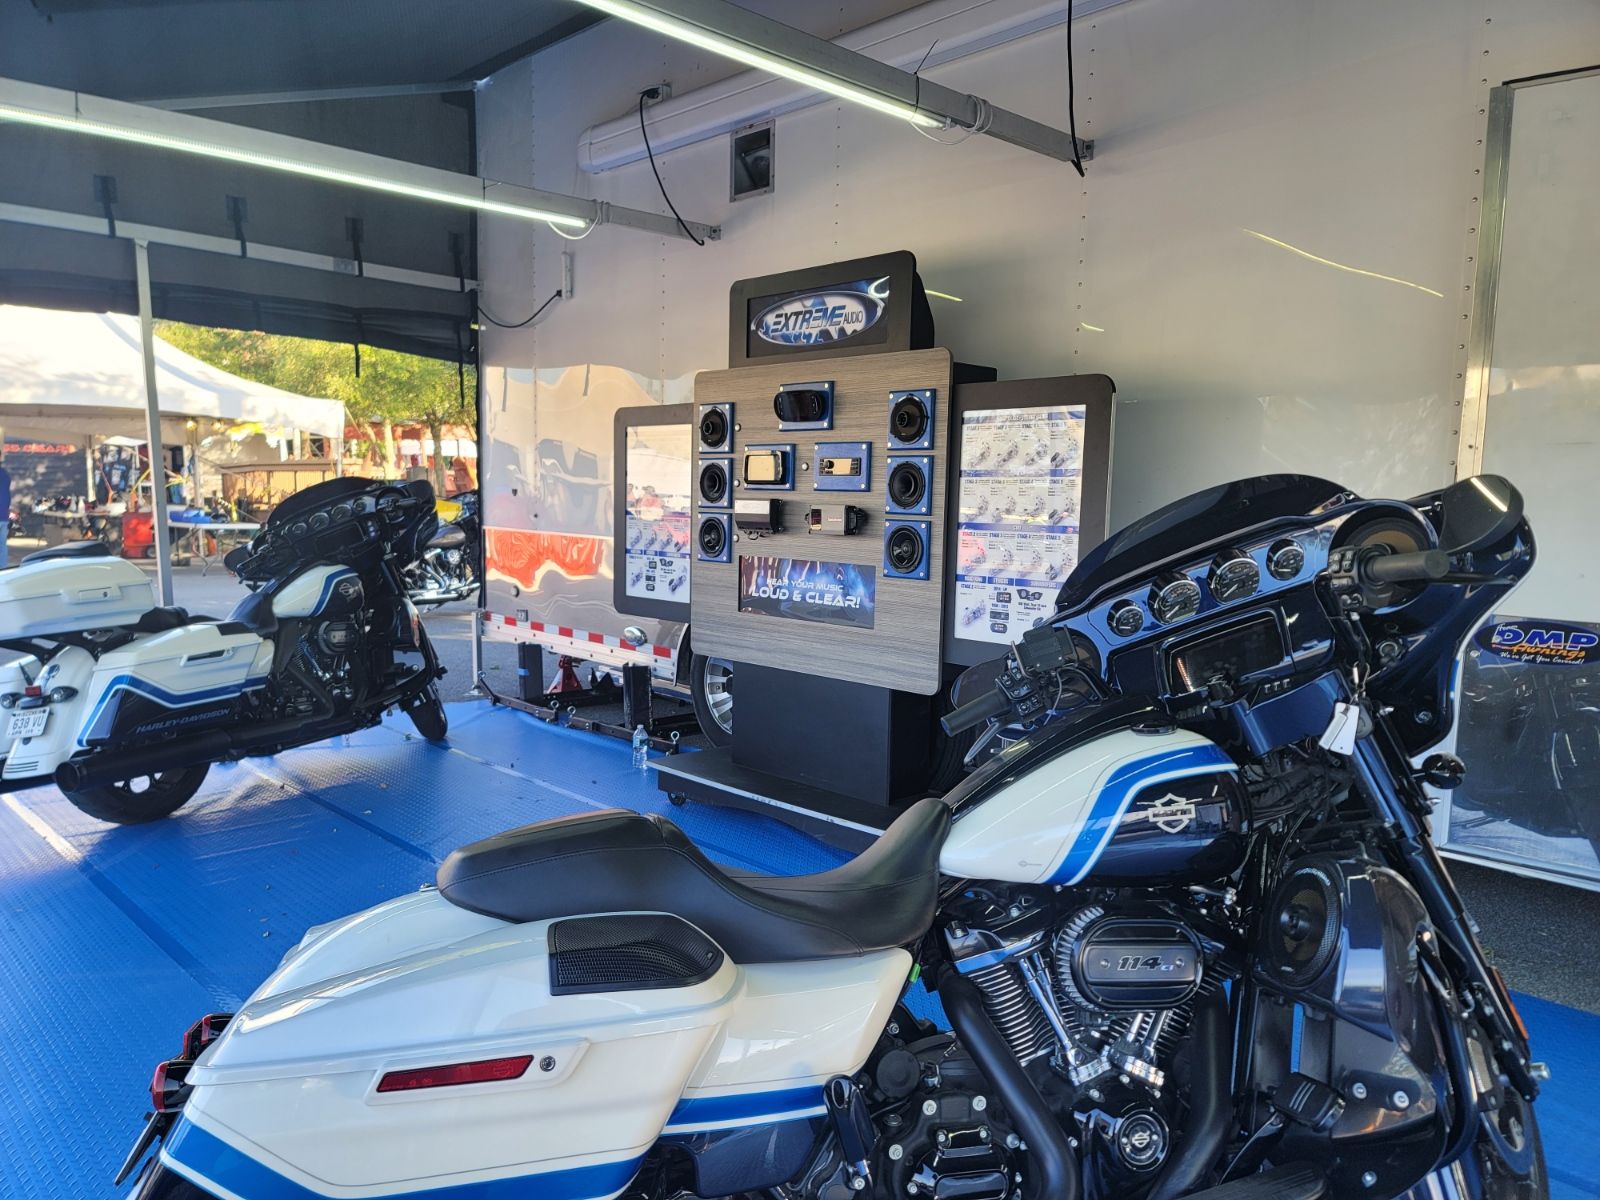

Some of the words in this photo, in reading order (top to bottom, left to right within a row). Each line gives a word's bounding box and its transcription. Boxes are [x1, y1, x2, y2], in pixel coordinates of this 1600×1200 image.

[771, 304, 847, 334] EXTREME
[842, 310, 864, 326] AUDIO
[766, 578, 789, 587] HEAR
[791, 580, 815, 590] YOUR
[815, 583, 844, 592] MUSIC
[752, 587, 789, 600] LOUD
[792, 590, 802, 602] &
[805, 591, 861, 609] CLEAR!
[1491, 628, 1599, 651] DMP
[1505, 643, 1586, 660] Awnings
[1536, 655, 1550, 664] You
[135, 707, 231, 734] HARLEY-DAVIDSON
[1117, 955, 1162, 971] 114
